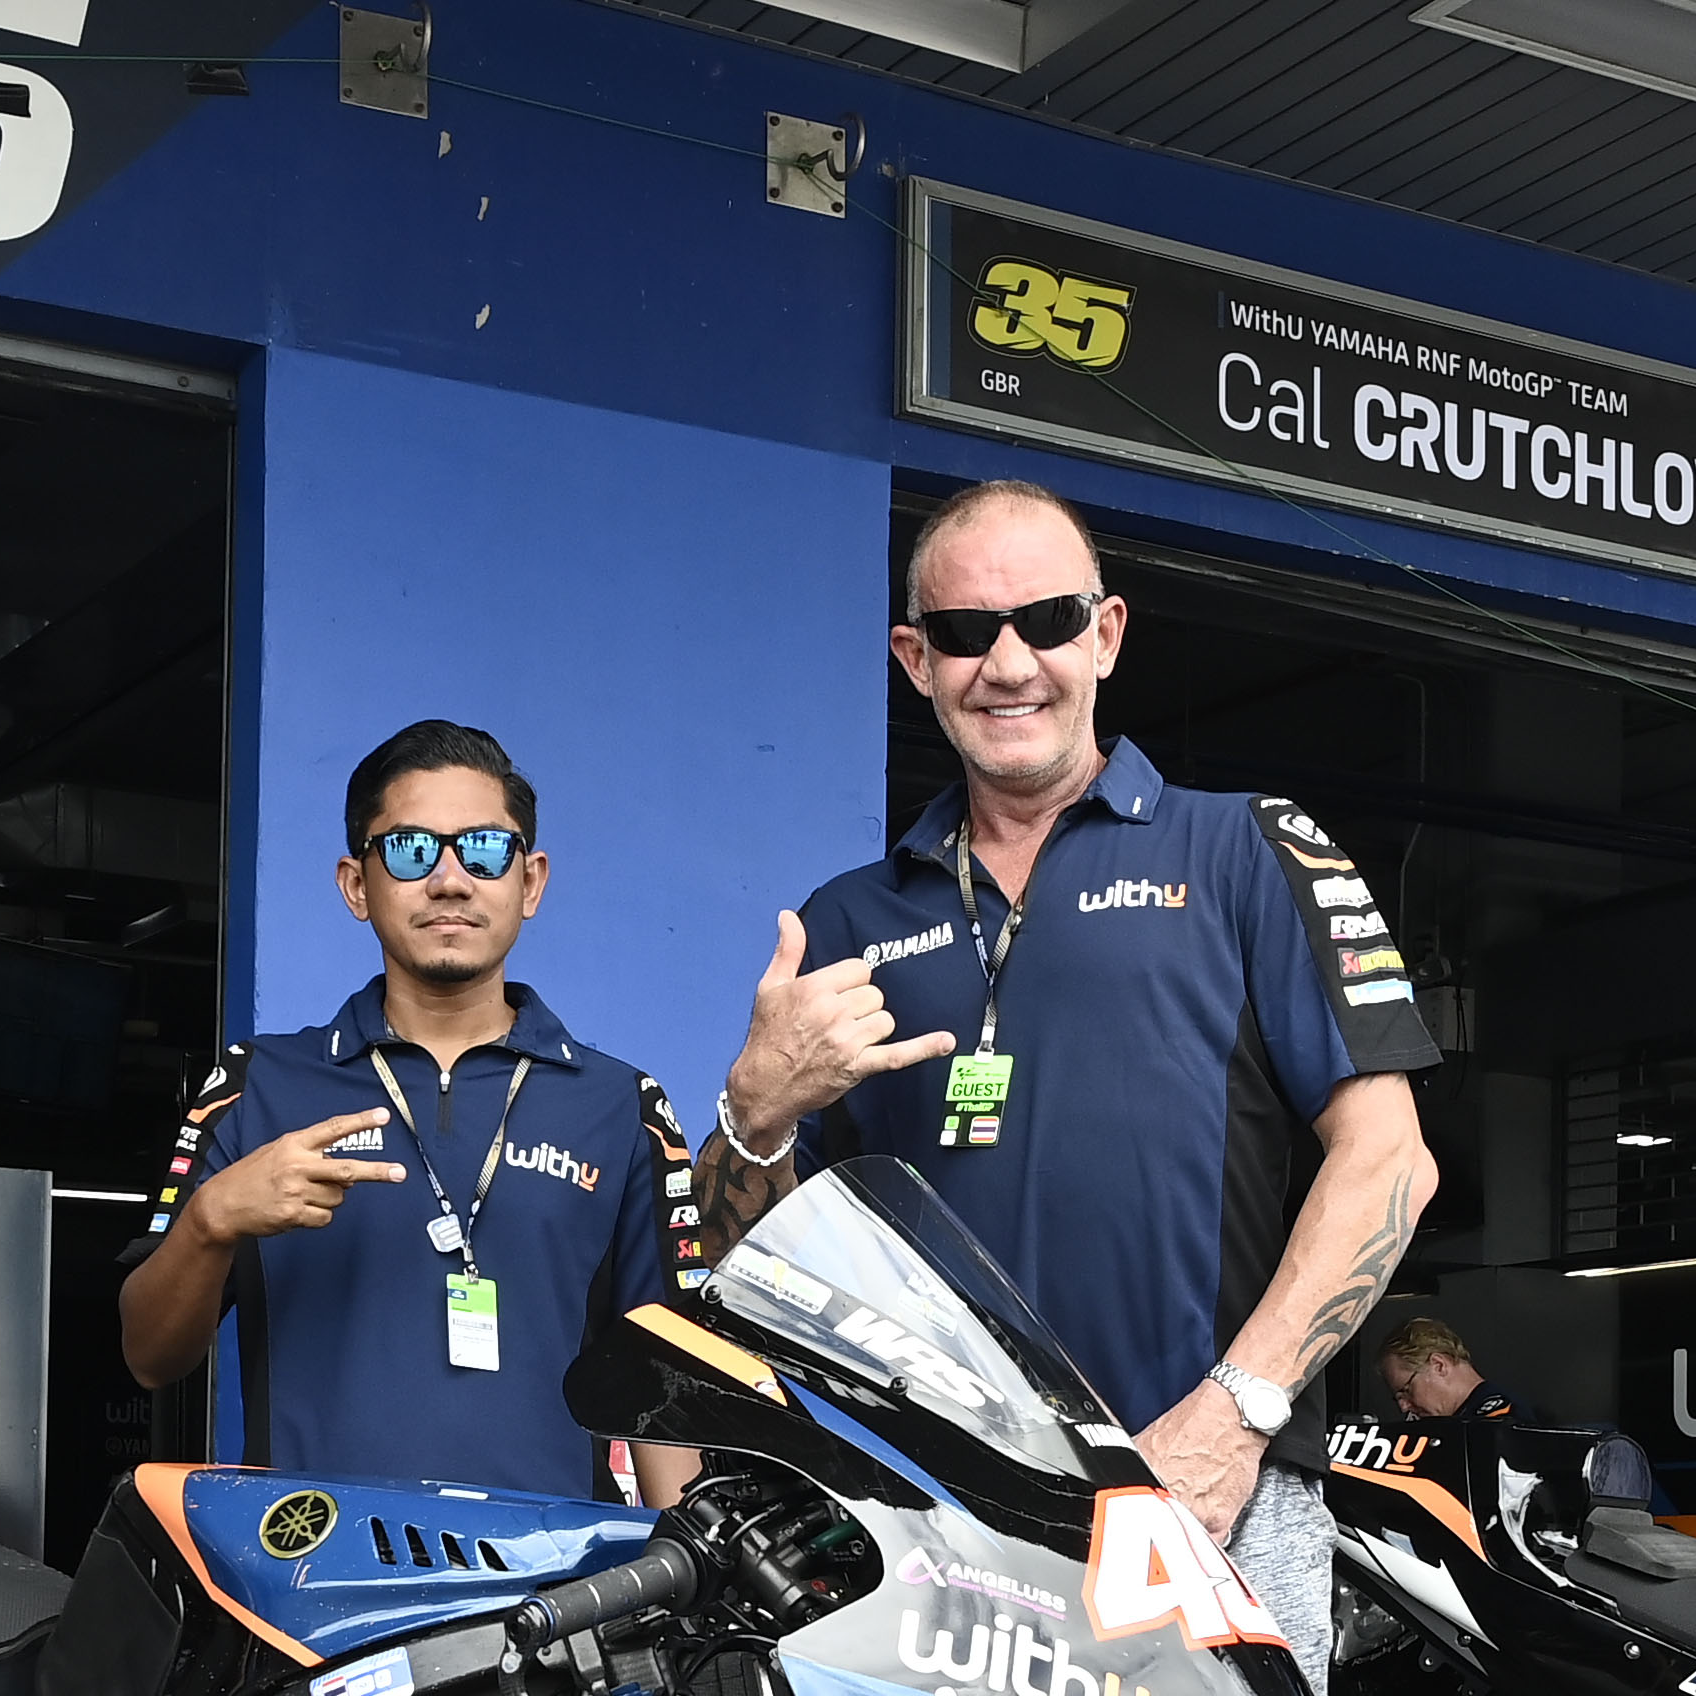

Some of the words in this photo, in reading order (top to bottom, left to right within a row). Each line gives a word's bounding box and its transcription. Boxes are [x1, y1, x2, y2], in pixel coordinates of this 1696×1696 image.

[971, 258, 1134, 372] 35
[981, 369, 1021, 397] GBR
[1230, 300, 1303, 341] WithU
[1310, 319, 1410, 367] YAMAHA
[1416, 345, 1462, 378] RNF
[1567, 381, 1628, 417] TEAM
[1217, 351, 1331, 451] Cal
[879, 921, 954, 959] YAMAHA
[952, 1083, 1005, 1097] GUEST
[834, 1306, 1004, 1408] WRS
[946, 1562, 1067, 1613] ANGELUSS
